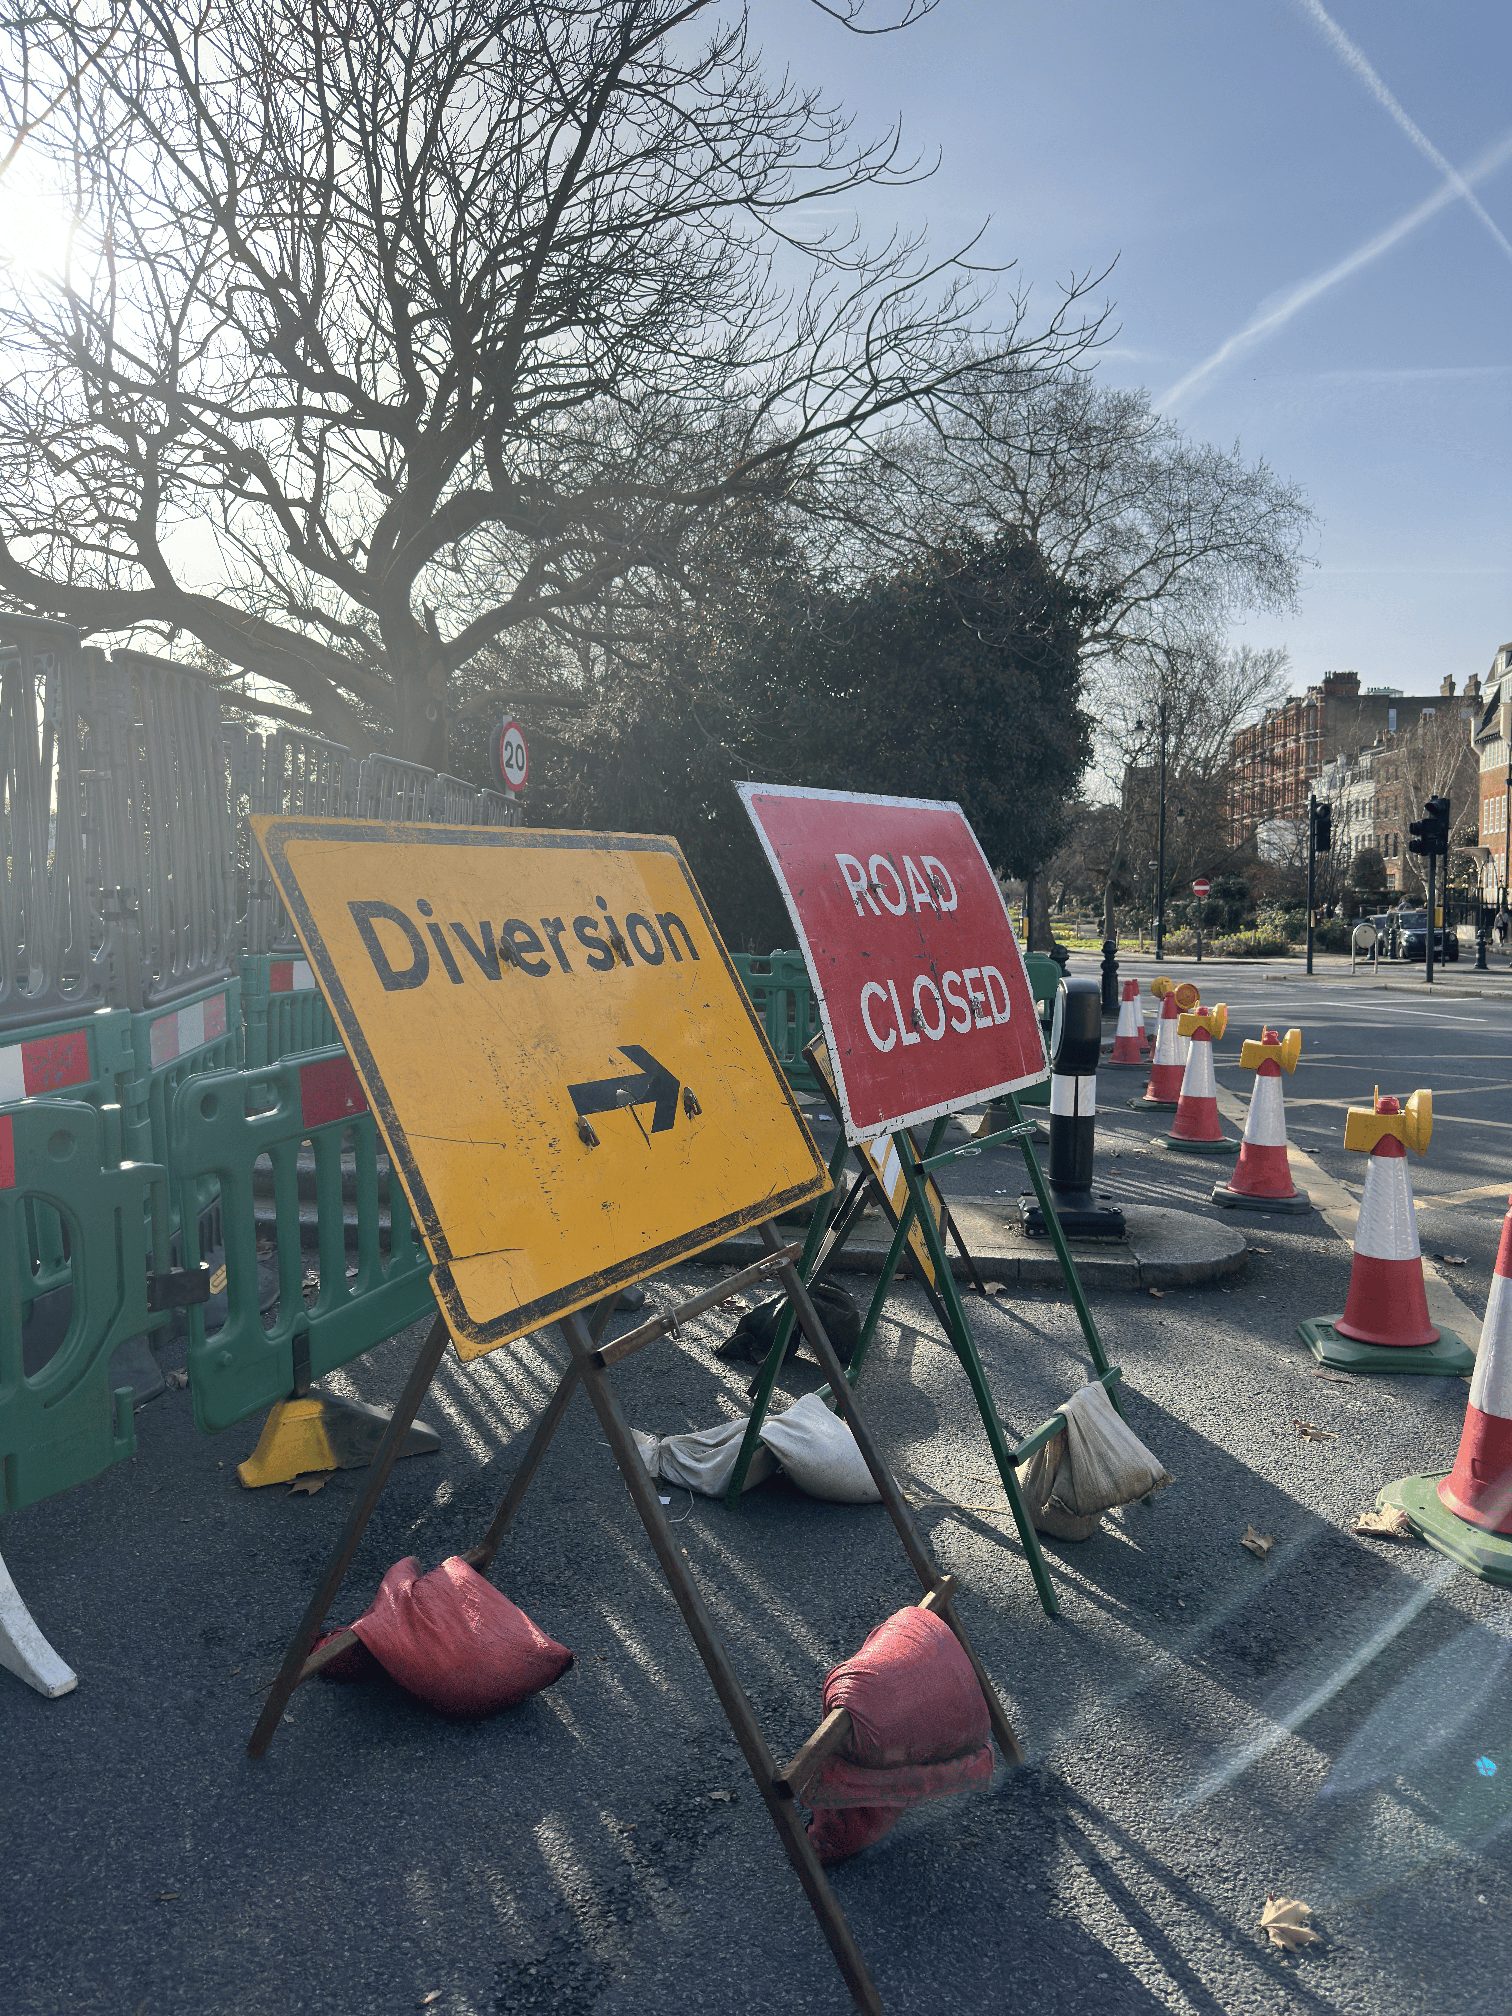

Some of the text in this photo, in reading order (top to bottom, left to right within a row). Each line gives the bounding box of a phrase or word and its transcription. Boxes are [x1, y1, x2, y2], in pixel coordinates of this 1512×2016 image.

[504, 741, 525, 772] 20
[835, 853, 958, 917] ROAD
[347, 895, 701, 992] Diversion
[860, 965, 1011, 1053] CLOSED
